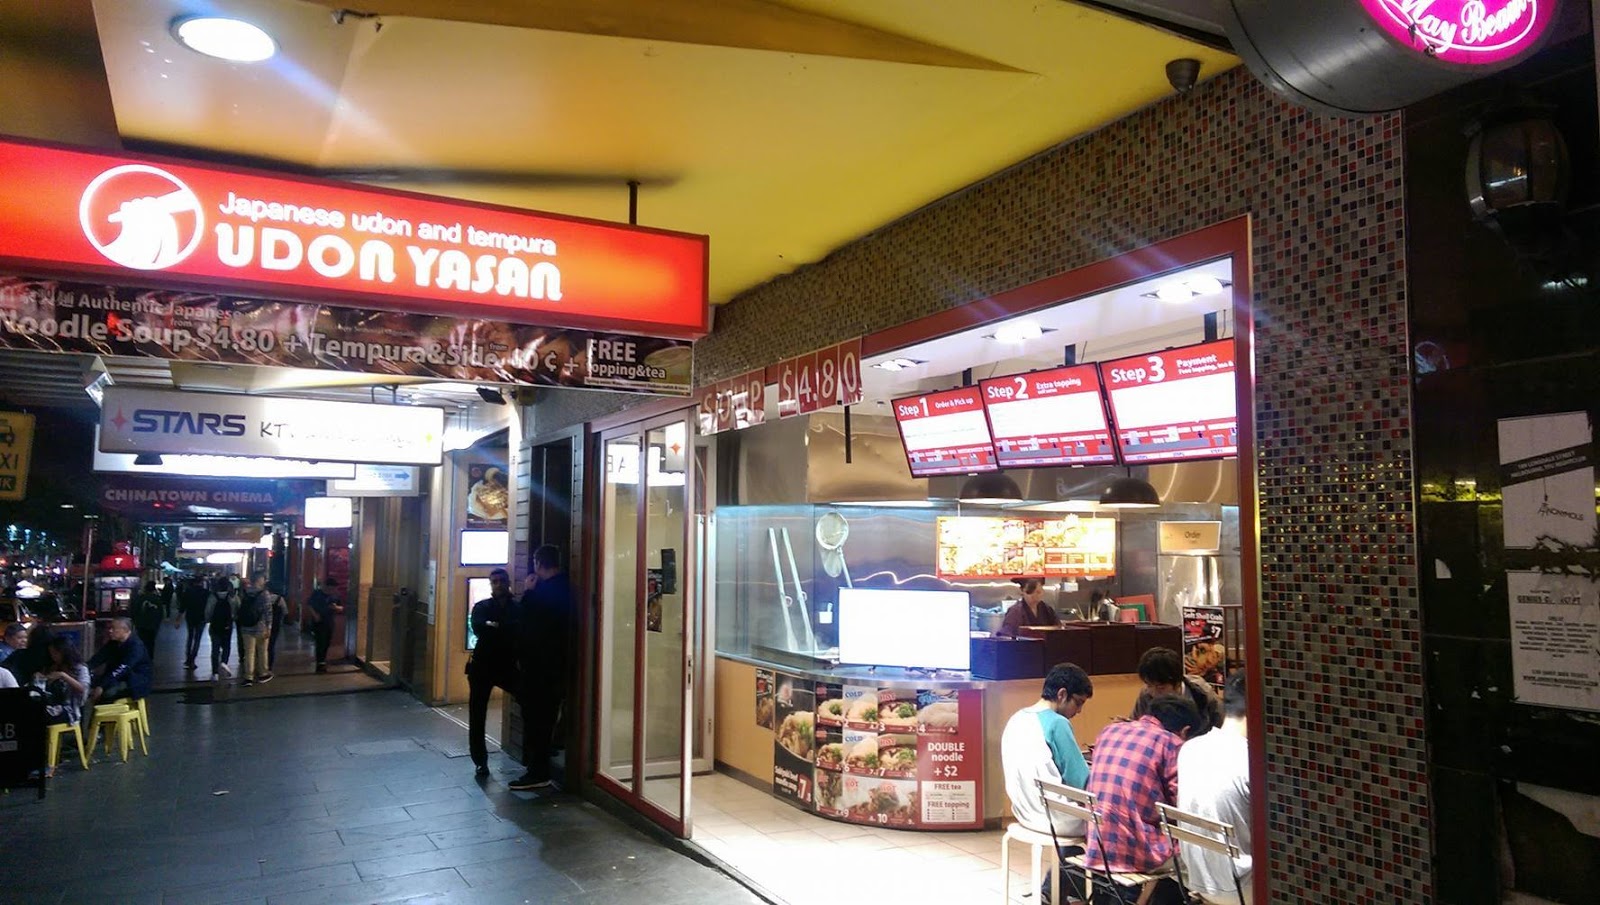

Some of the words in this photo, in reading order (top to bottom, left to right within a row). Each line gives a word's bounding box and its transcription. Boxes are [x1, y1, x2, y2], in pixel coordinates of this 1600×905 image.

[219, 192, 346, 229] Japanese
[352, 212, 412, 238] udon
[417, 221, 462, 244] and
[466, 225, 557, 256] tempura
[215, 223, 397, 283] UDON
[407, 246, 563, 301] YASAN
[79, 291, 166, 315] Authentic
[167, 301, 242, 321] Japanese
[0, 309, 108, 341] Noodle
[115, 318, 192, 352] Soup
[196, 323, 275, 353] $4.80
[587, 339, 637, 363] FREE
[1176, 354, 1217, 368] Payment
[783, 352, 857, 404] $4.80
[1111, 368, 1147, 383] Step
[1147, 355, 1166, 382] 3
[987, 385, 1014, 399] Step
[1014, 376, 1029, 399] 2
[1036, 381, 1054, 390] Extra
[1053, 378, 1082, 389] topping
[898, 405, 919, 417] Step
[919, 397, 930, 417] 1
[935, 401, 950, 409] Order
[954, 397, 966, 406] Pick
[966, 397, 974, 405] up
[132, 409, 246, 436] STARS
[260, 421, 297, 438] KT
[105, 489, 208, 502] CHINATOWN
[212, 492, 274, 504] CINEMA
[1211, 625, 1222, 638] $7
[927, 742, 965, 752] DOUBLE
[932, 752, 964, 761] noodle
[944, 765, 958, 777] $2
[877, 813, 888, 823] 10
